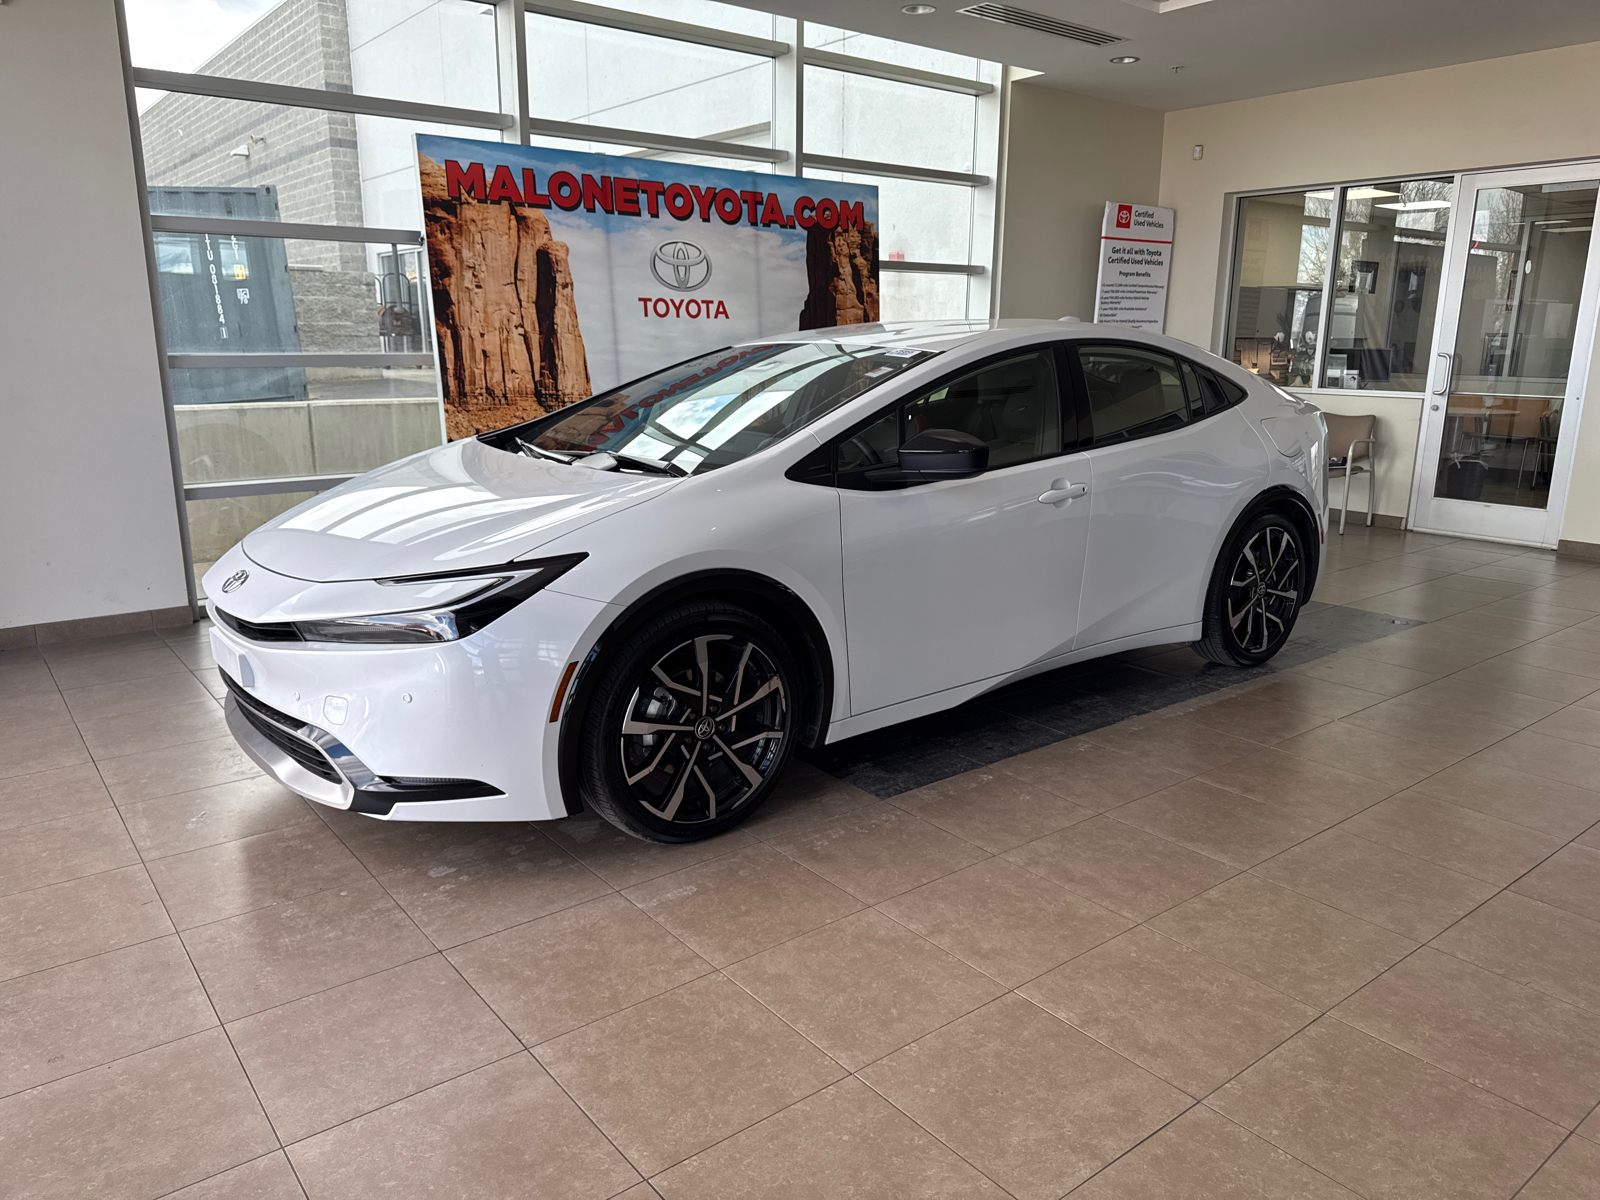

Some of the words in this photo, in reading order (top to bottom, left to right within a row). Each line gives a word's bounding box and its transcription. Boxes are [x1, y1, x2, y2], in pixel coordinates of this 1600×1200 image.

[444, 159, 865, 232] MALONETOYOTA.COM
[1134, 210, 1155, 219] Certified
[1133, 219, 1145, 227] Used
[1146, 220, 1164, 229] Vehicles
[1111, 247, 1121, 255] Get
[1122, 247, 1127, 255] it
[1134, 248, 1146, 256] with
[1146, 248, 1162, 258] Toyota
[1107, 256, 1130, 265] Certified
[1130, 257, 1143, 265] Used
[1144, 258, 1164, 267] Vehicles
[1118, 270, 1135, 278] Program
[638, 297, 730, 320] TOYOTA
